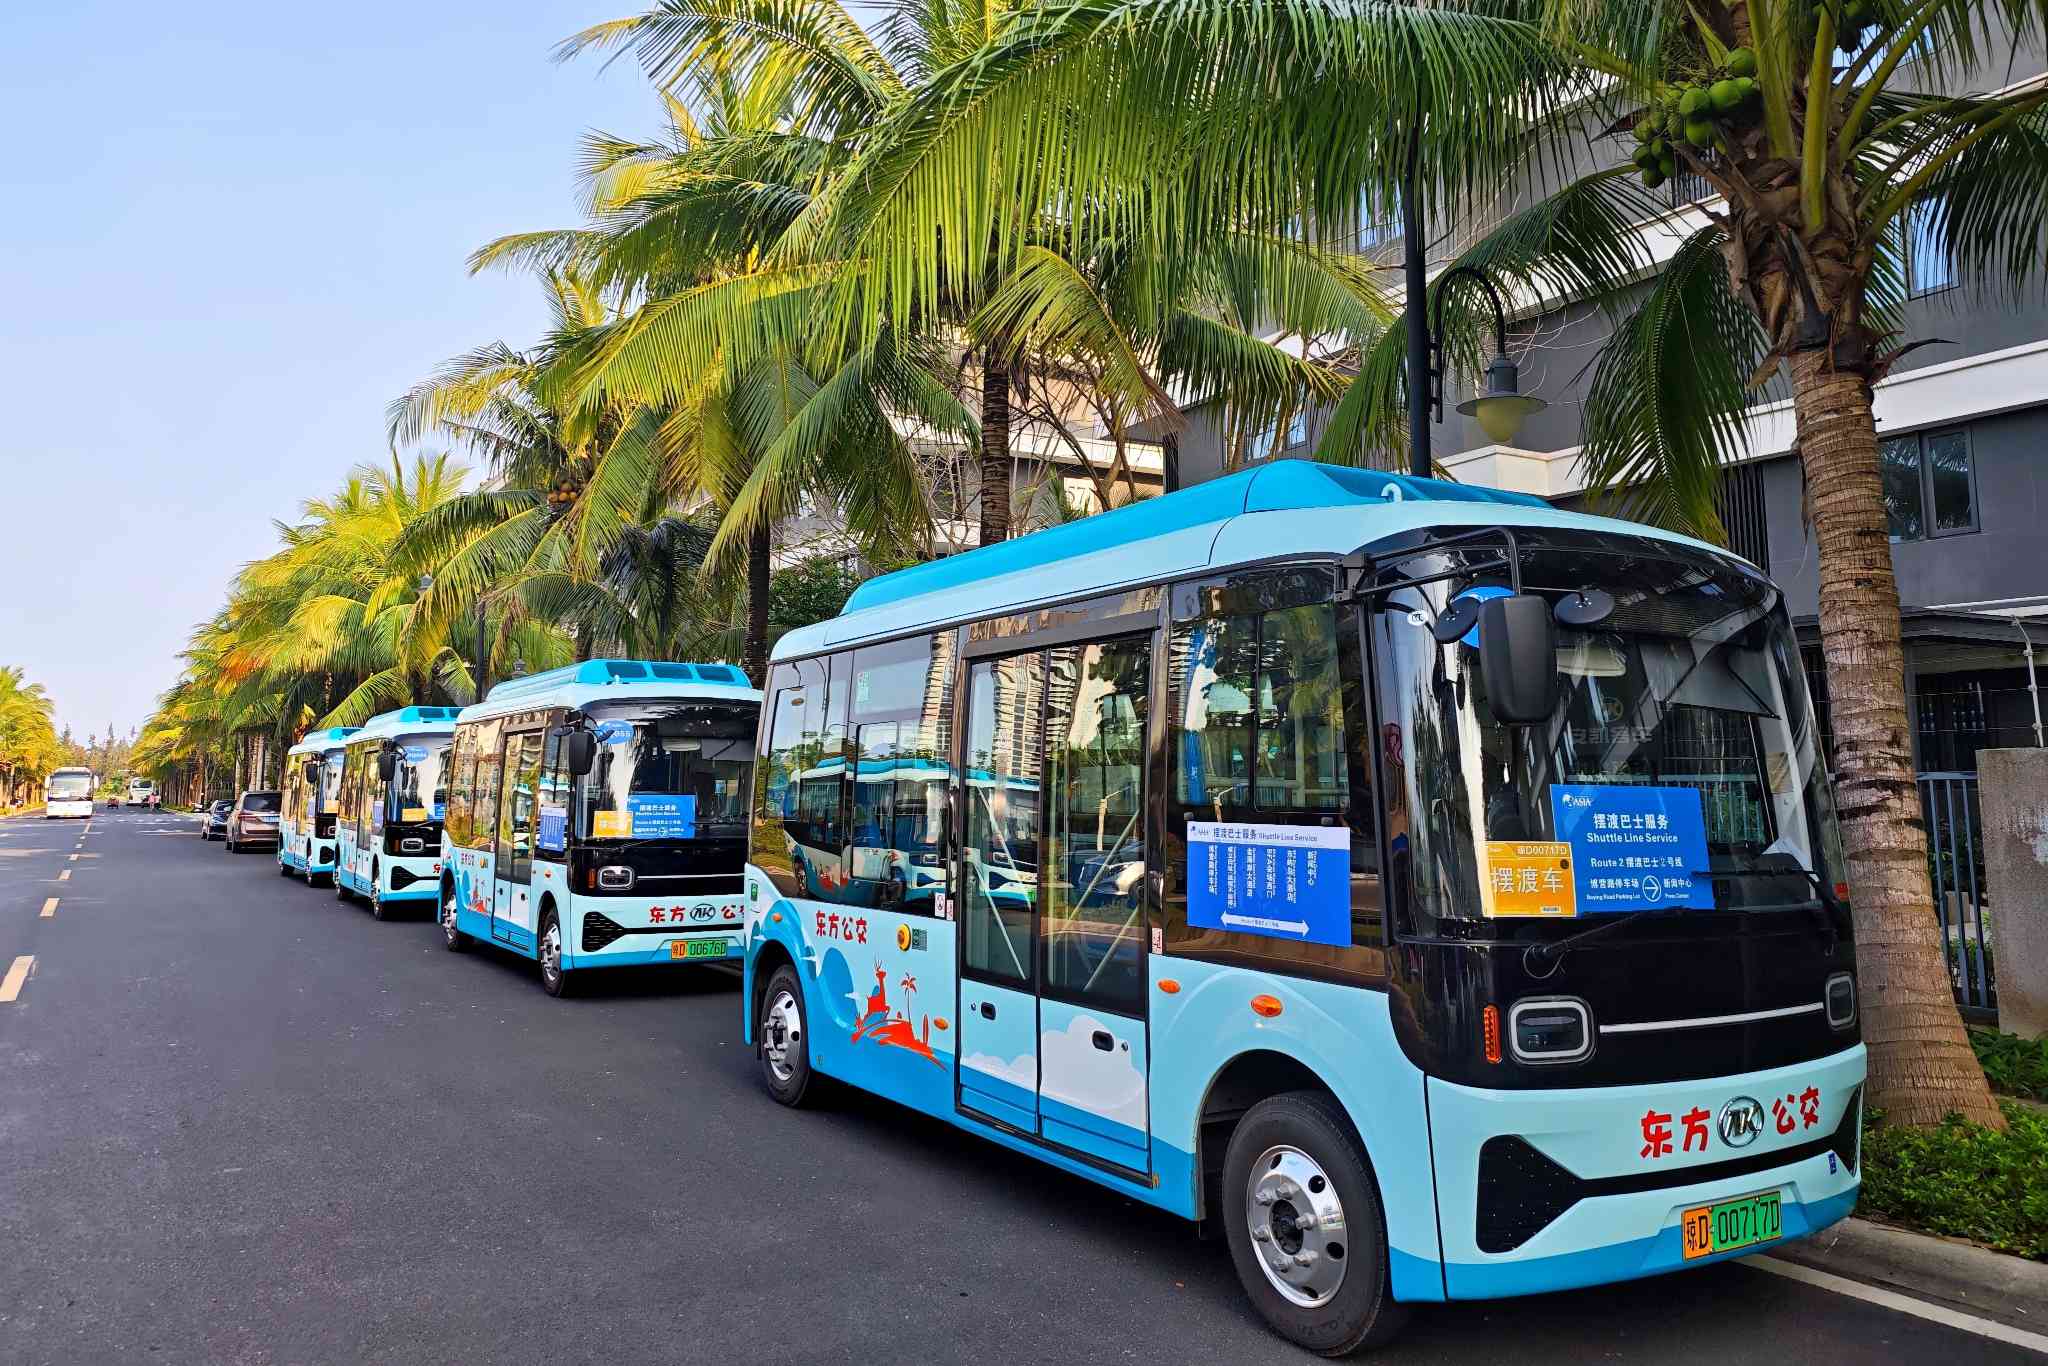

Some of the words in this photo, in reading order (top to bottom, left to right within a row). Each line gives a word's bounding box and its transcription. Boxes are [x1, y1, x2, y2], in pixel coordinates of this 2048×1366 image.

[1593, 813, 1669, 829] 摆渡巴士服务
[1587, 832, 1621, 843] Shuttle
[1623, 832, 1644, 843] Line
[1645, 832, 1678, 843] Service
[1590, 858, 1617, 868] Route
[1490, 866, 1564, 893] 摆渡车
[650, 906, 686, 923] 东方
[816, 910, 867, 945] 东方公交
[1772, 1086, 1820, 1135] 公交
[1640, 1106, 1711, 1158] 东方
